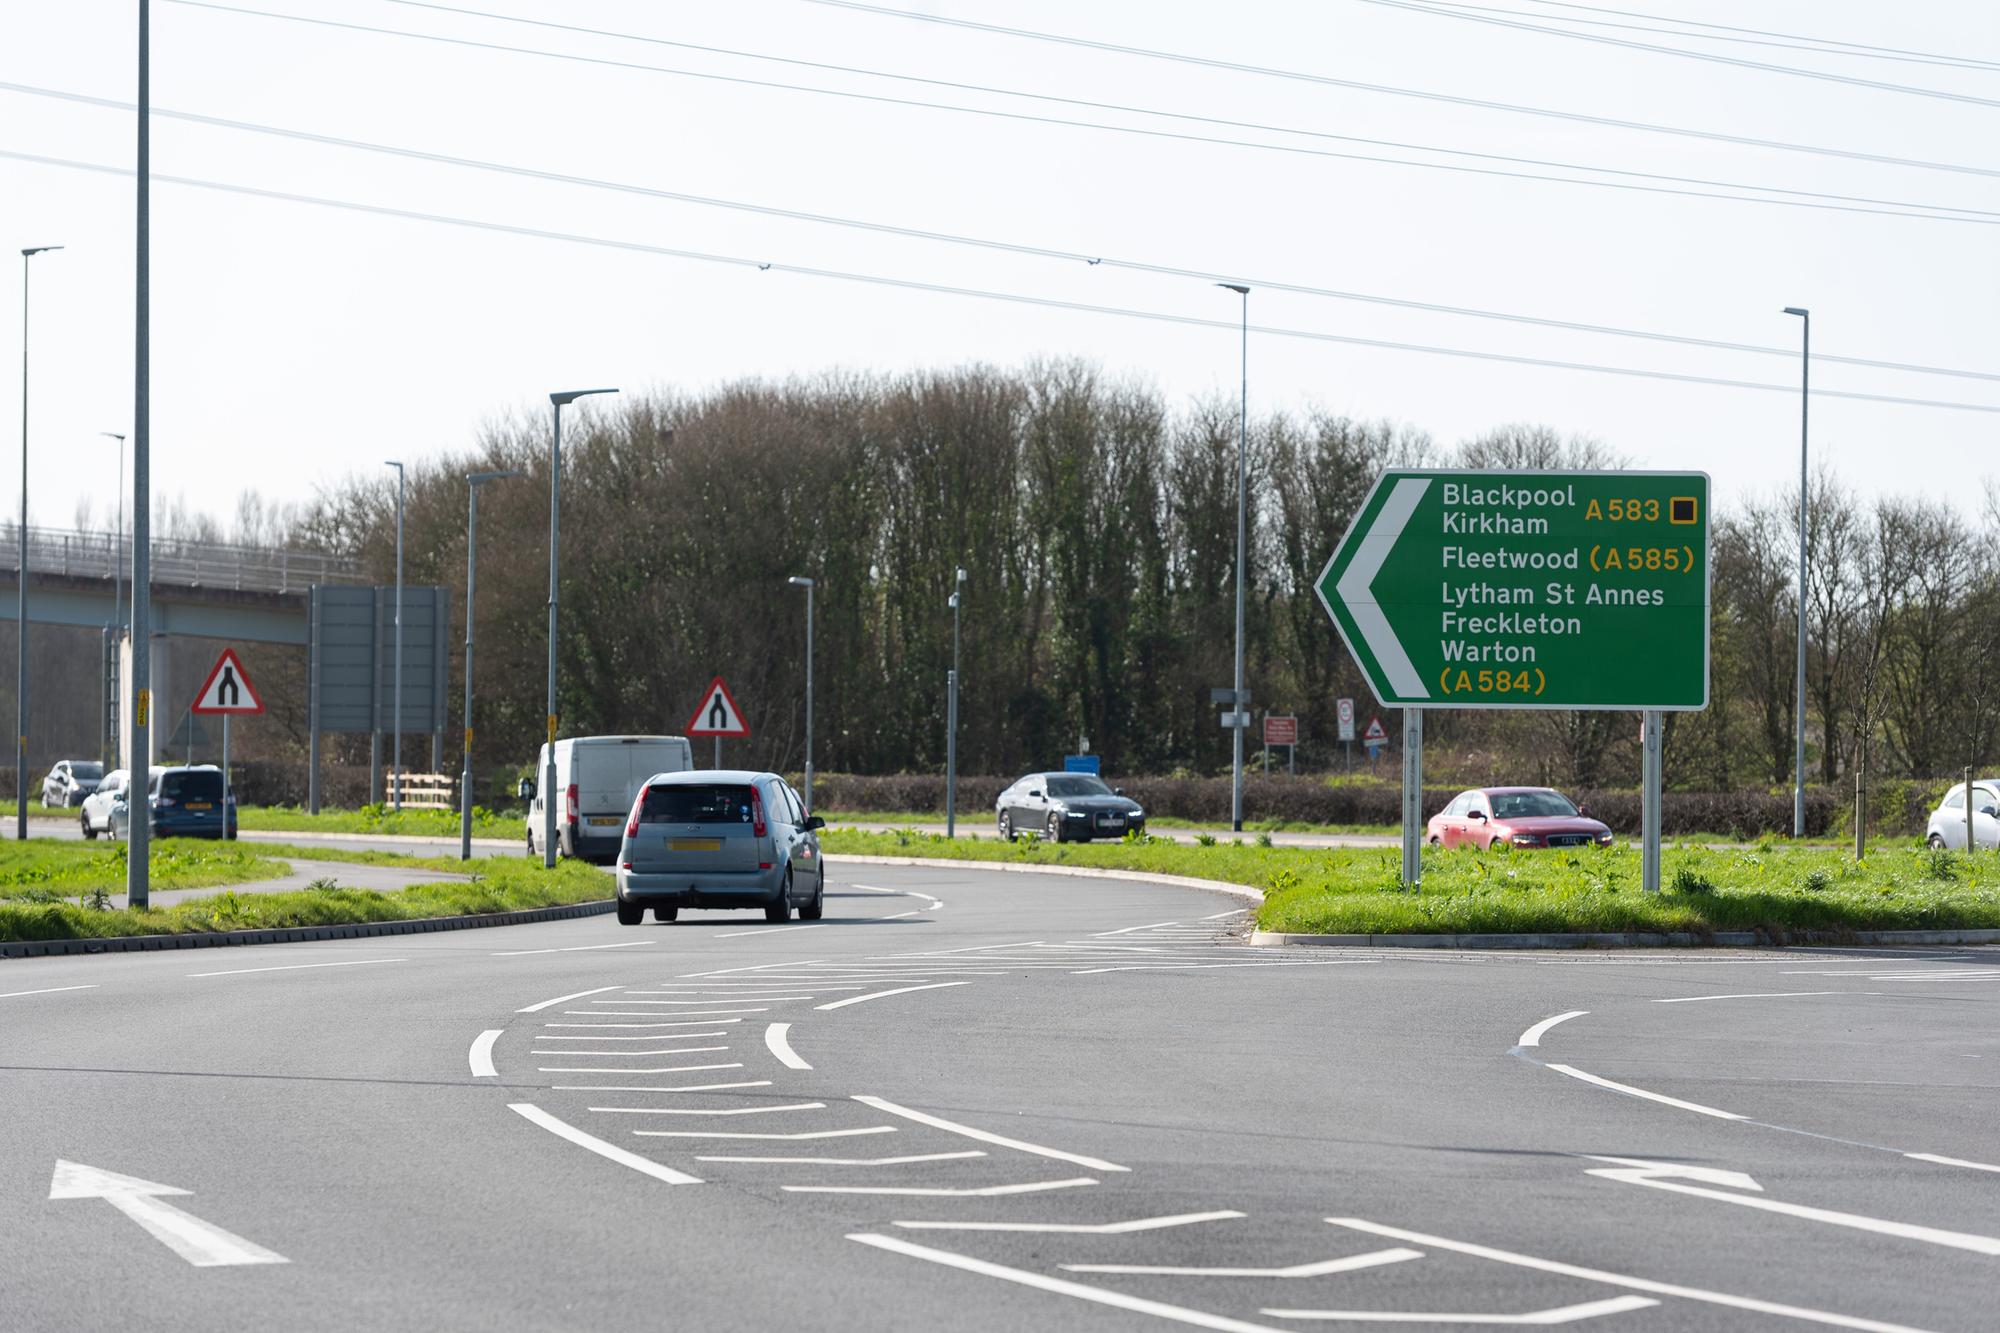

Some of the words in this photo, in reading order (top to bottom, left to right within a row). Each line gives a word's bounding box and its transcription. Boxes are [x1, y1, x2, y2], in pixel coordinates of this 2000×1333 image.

[1443, 483, 1575, 510] Blackpool
[1443, 511, 1549, 534] Kirkham
[1442, 546, 1579, 569] Fleetwood
[1442, 582, 1535, 608] Lytham
[1546, 582, 1575, 605] St
[1585, 583, 1665, 605] Annes
[1441, 611, 1582, 634] Freckleton
[1440, 639, 1537, 662] Warton
